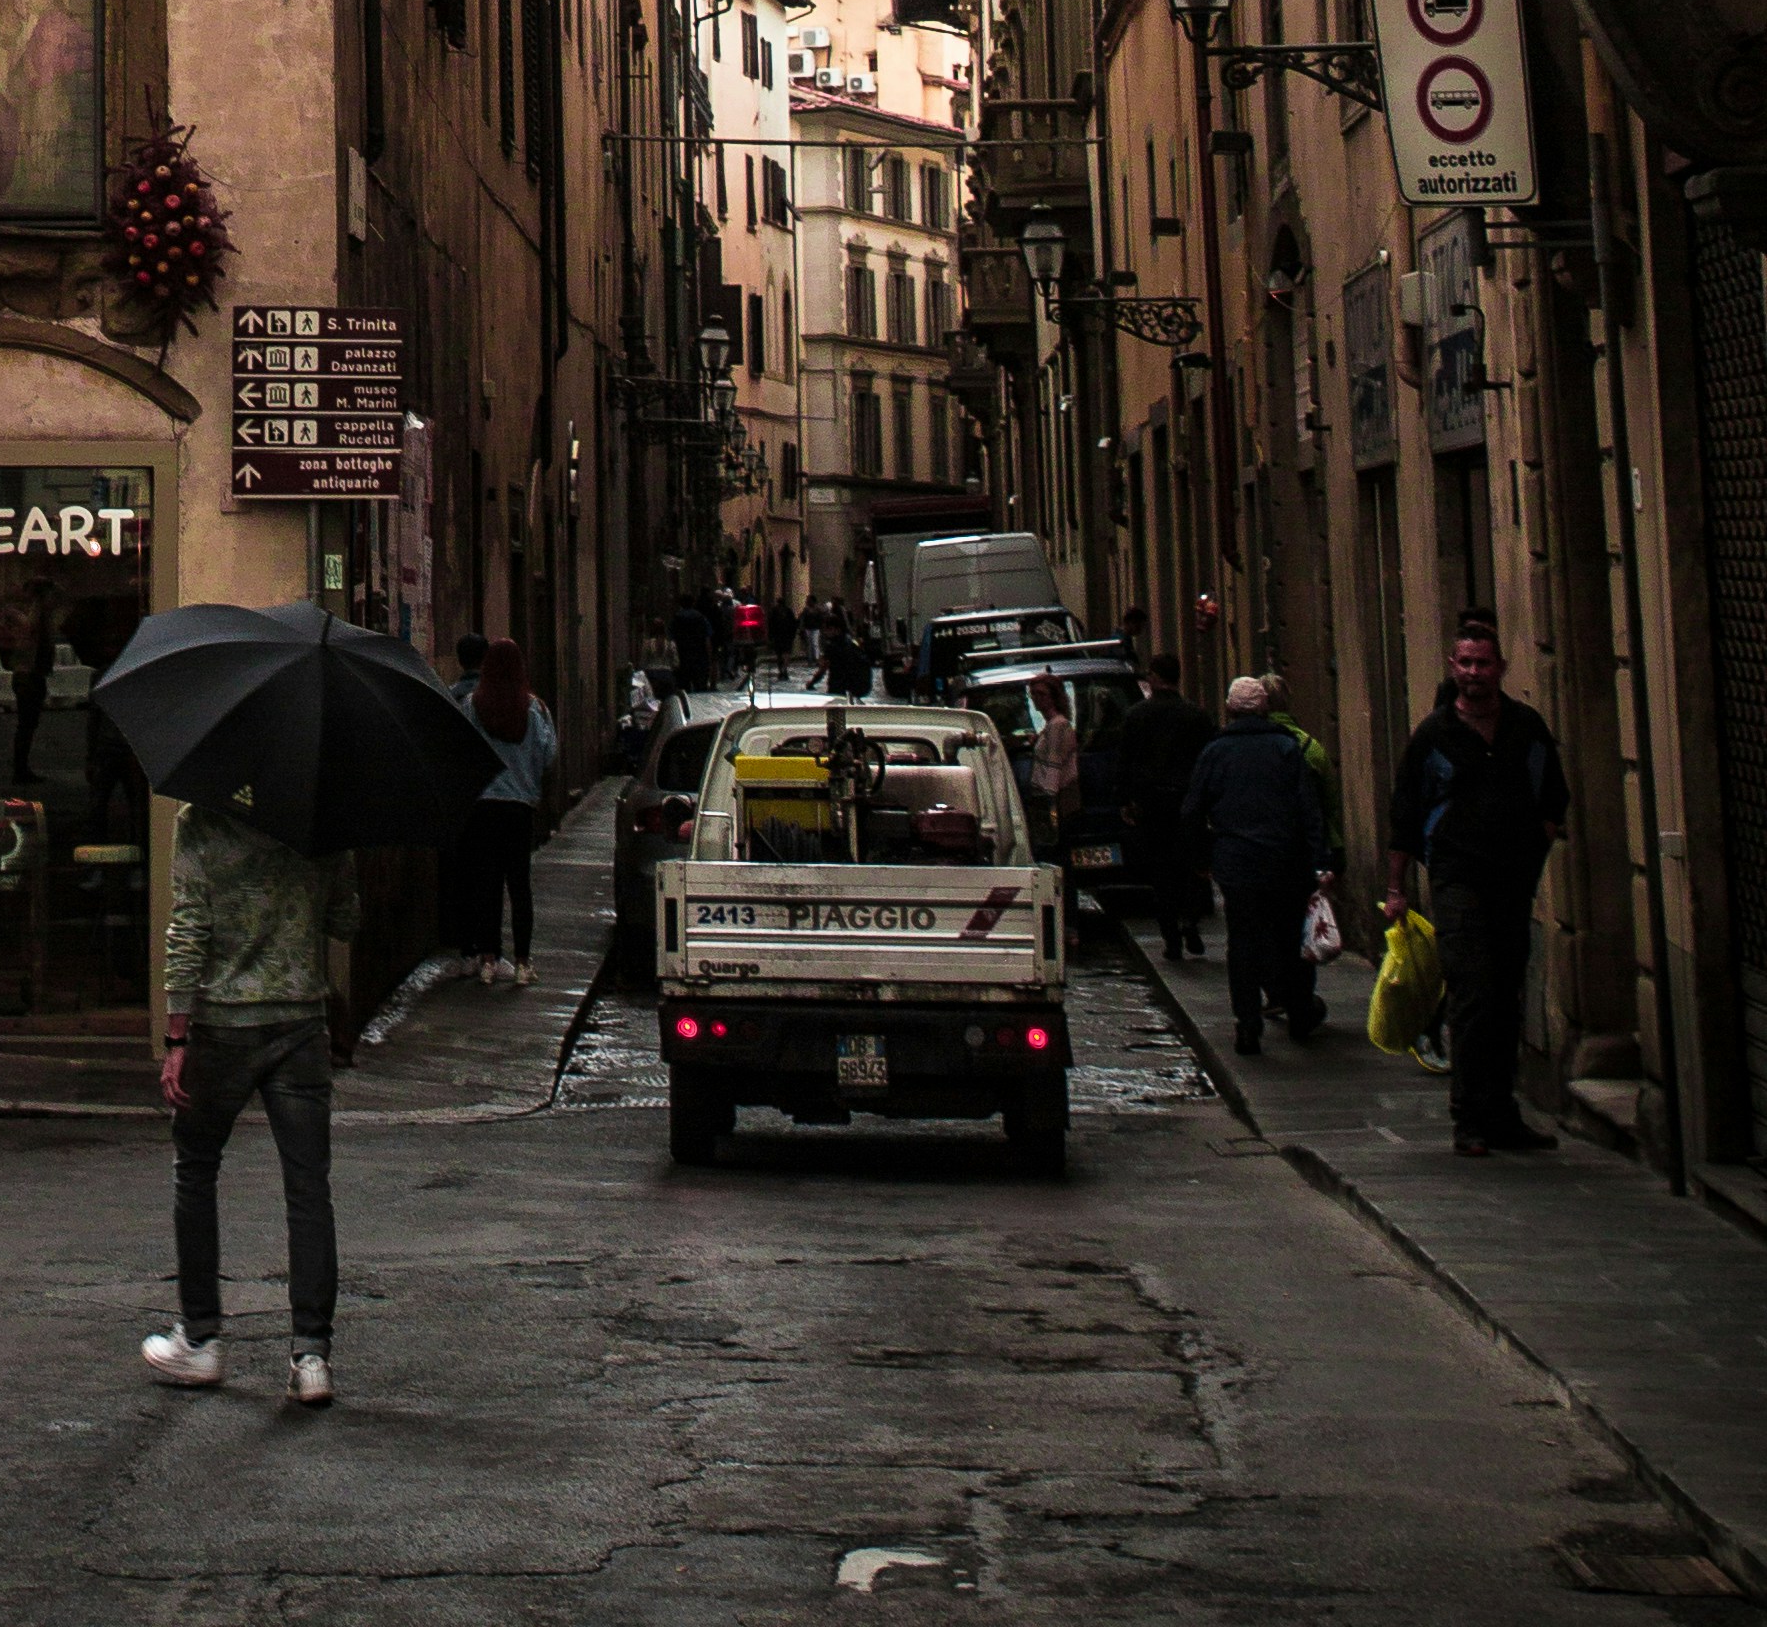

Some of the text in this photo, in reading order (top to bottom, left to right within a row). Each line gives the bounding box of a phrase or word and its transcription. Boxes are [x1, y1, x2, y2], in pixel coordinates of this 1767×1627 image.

[1428, 150, 1496, 167] eccetto
[1418, 171, 1518, 194] autorizzati
[327, 317, 341, 330] S.
[345, 347, 396, 359] palazzo
[331, 361, 397, 372] Davanzati
[354, 385, 397, 395] museo
[336, 397, 397, 409] M. Marini
[334, 420, 394, 432] cappella
[338, 433, 395, 445] Rucellai
[299, 456, 393, 473] zona botteghe
[312, 475, 380, 492] antiquarie
[697, 904, 937, 931] 2413 PIAGGIO
[698, 959, 760, 977] Quargo
